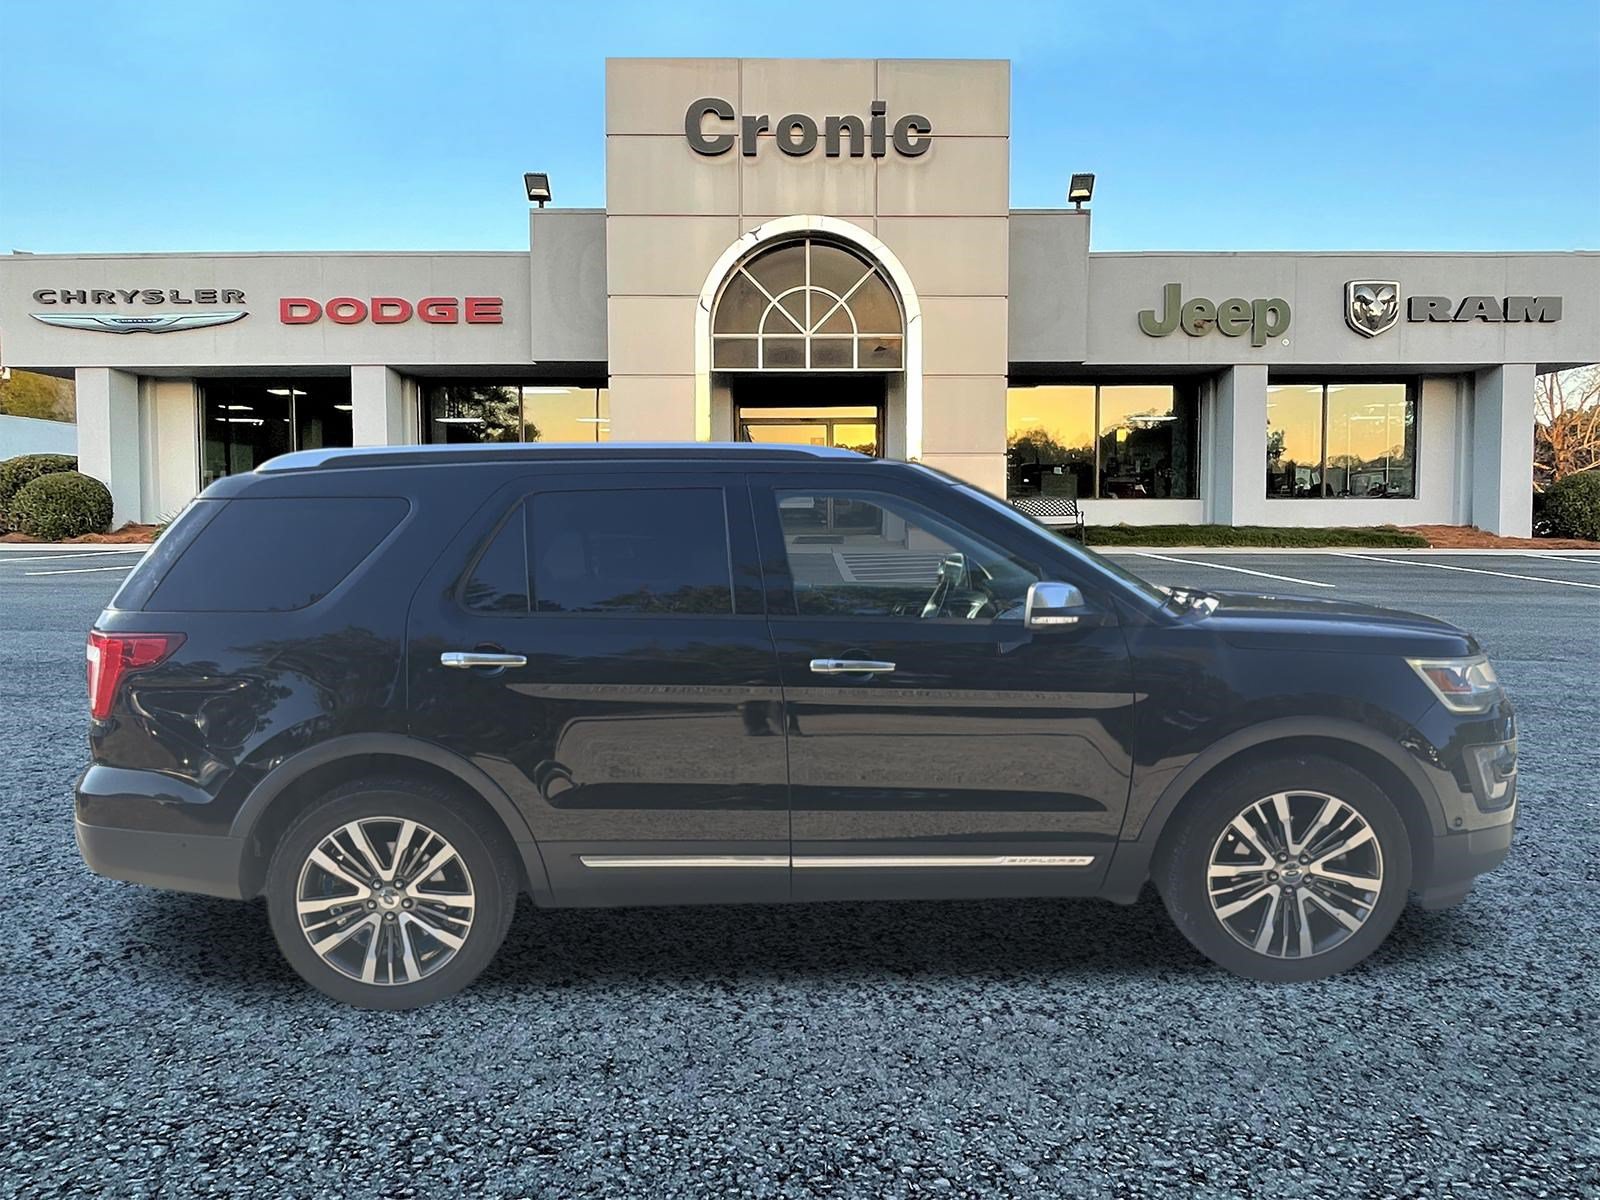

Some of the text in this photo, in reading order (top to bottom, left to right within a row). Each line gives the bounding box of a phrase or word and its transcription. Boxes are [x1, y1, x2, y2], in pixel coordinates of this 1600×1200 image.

[685, 98, 932, 157] Cronic
[32, 288, 247, 304] CHRYSLER
[279, 296, 504, 325] DODGE
[1407, 296, 1563, 323] RAM
[1138, 283, 1292, 347] Jeep
